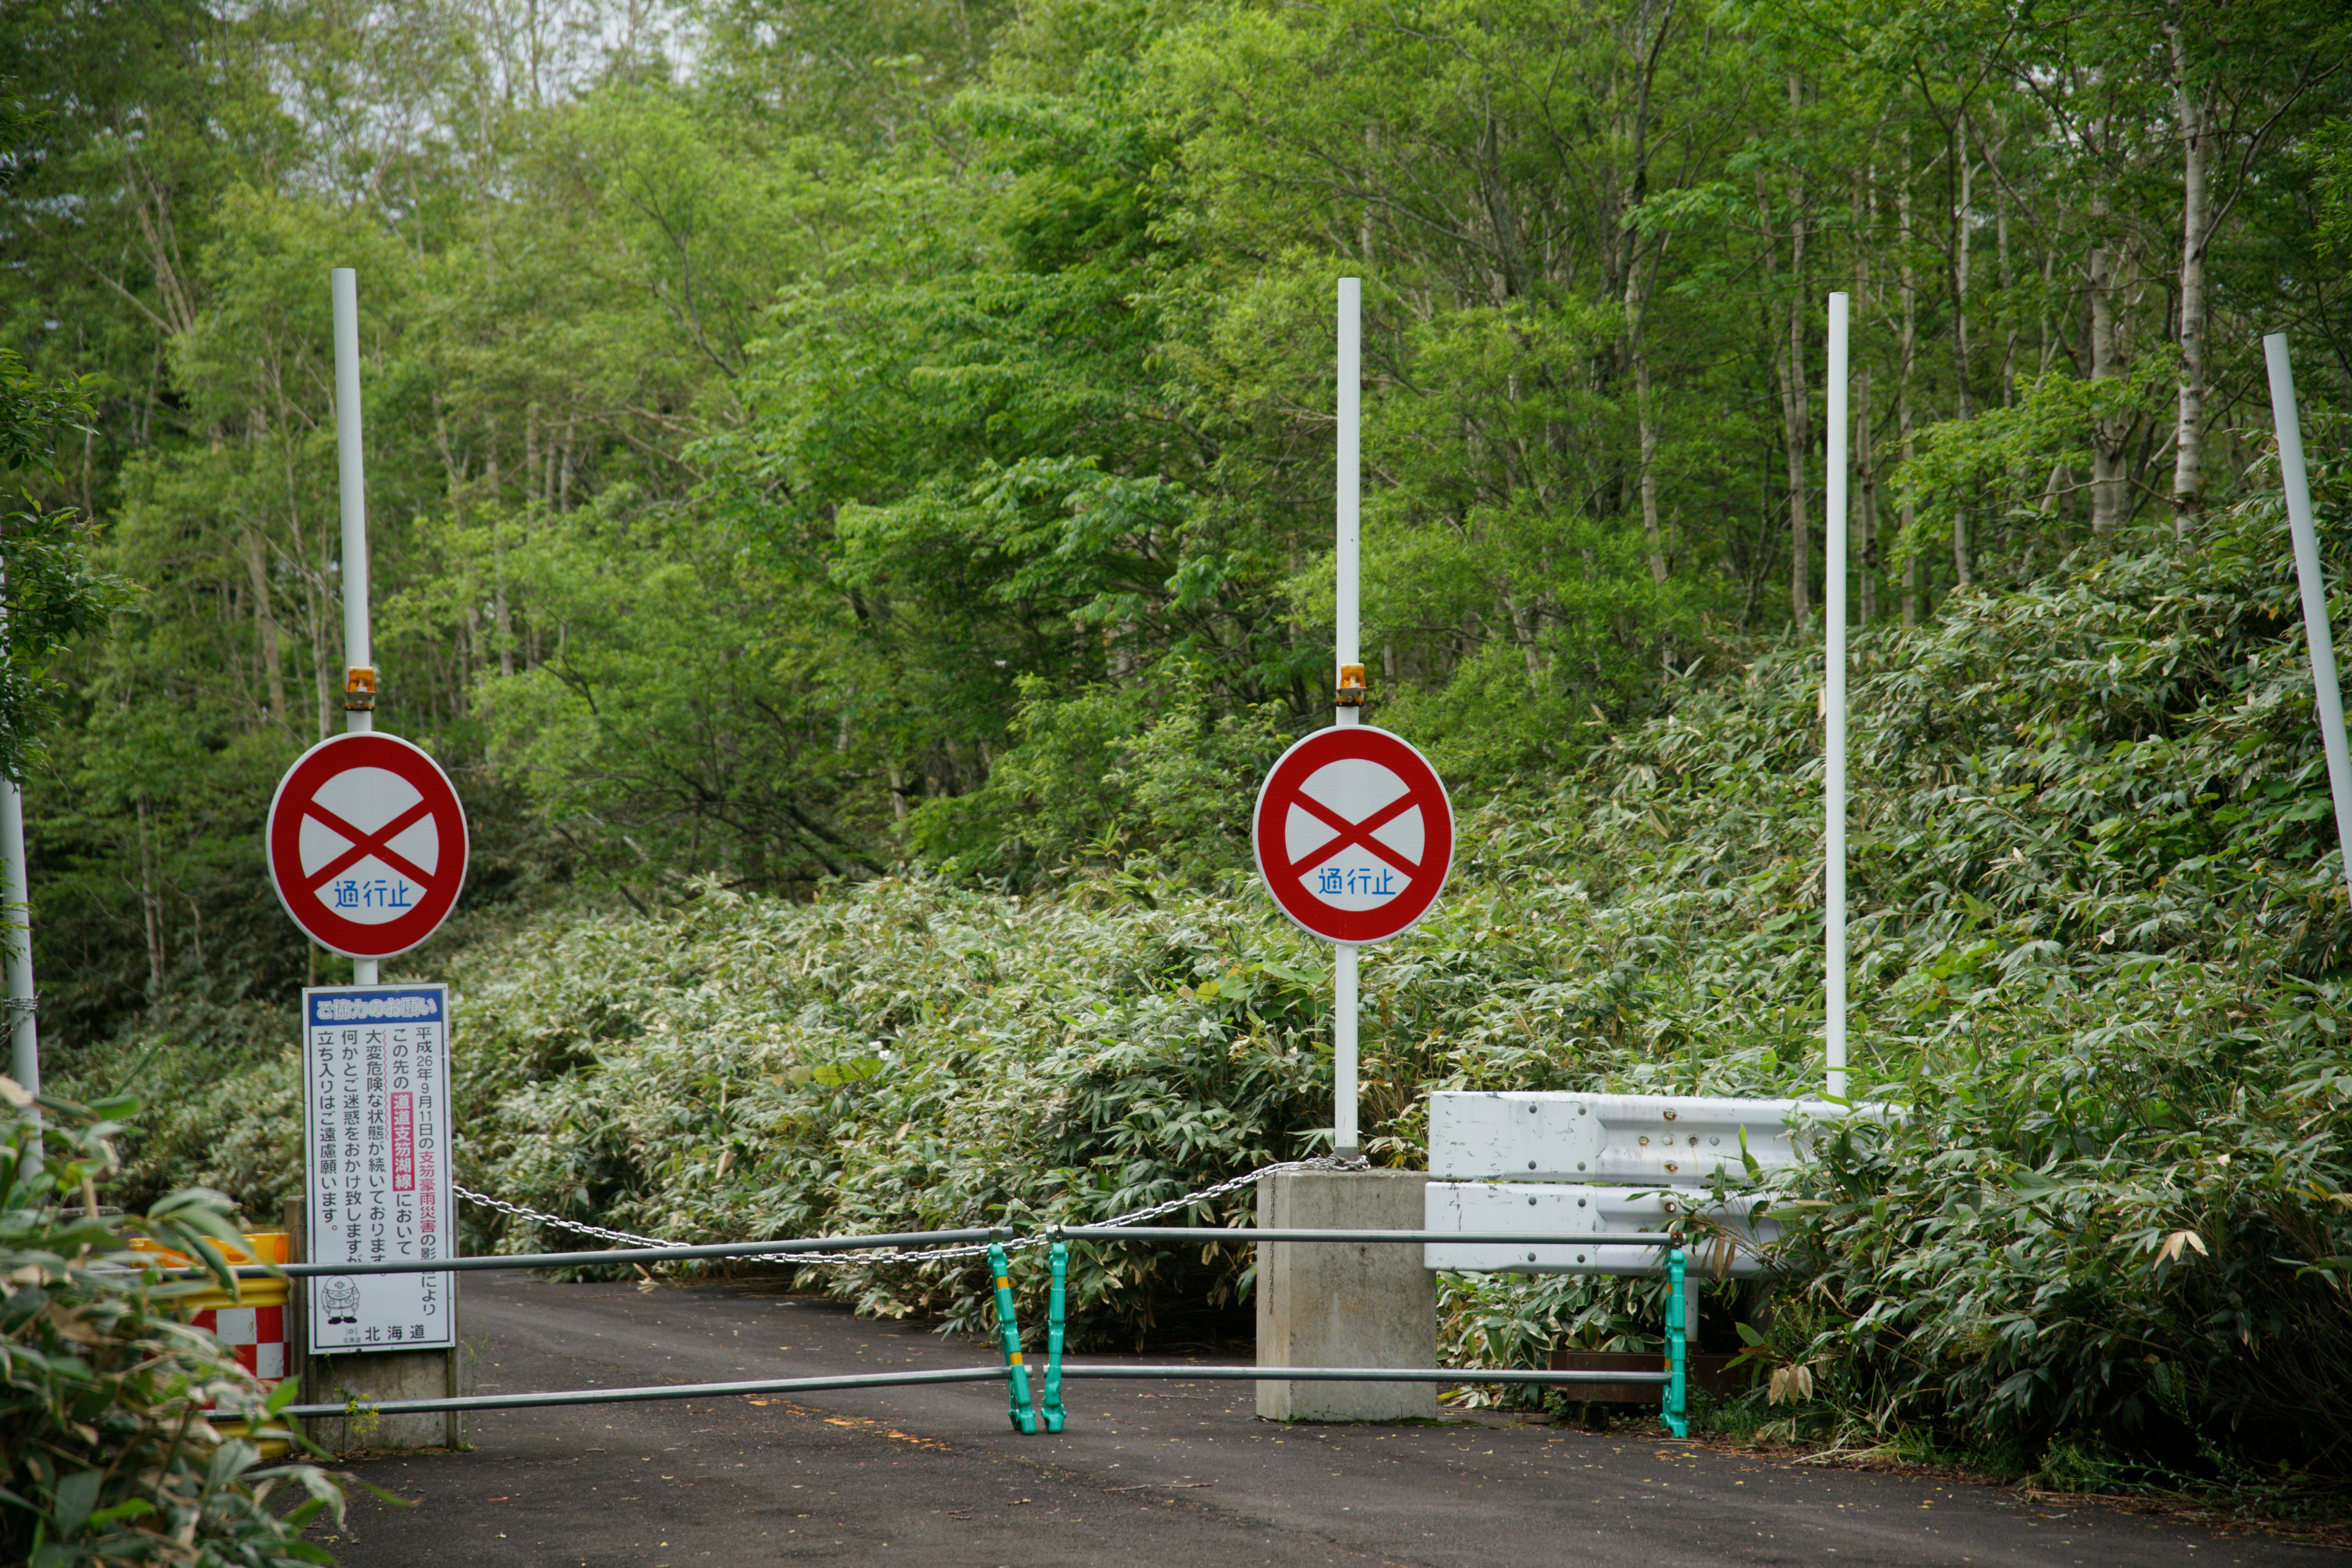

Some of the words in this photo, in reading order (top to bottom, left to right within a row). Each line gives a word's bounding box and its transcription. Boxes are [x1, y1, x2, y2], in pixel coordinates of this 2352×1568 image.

[334, 880, 412, 907] 通行止
[1318, 868, 1396, 895] 通行止
[317, 997, 437, 1020] ご協力のお願い
[318, 1031, 337, 1230] 立ち入りはご遠慮願います。
[342, 1030, 362, 1275] 何かとご迷惑をおかけ致しますが
[416, 1027, 436, 1316] 平成26年9月11日の支笏豪雨災害の影により
[365, 1324, 425, 1341] 北海道
